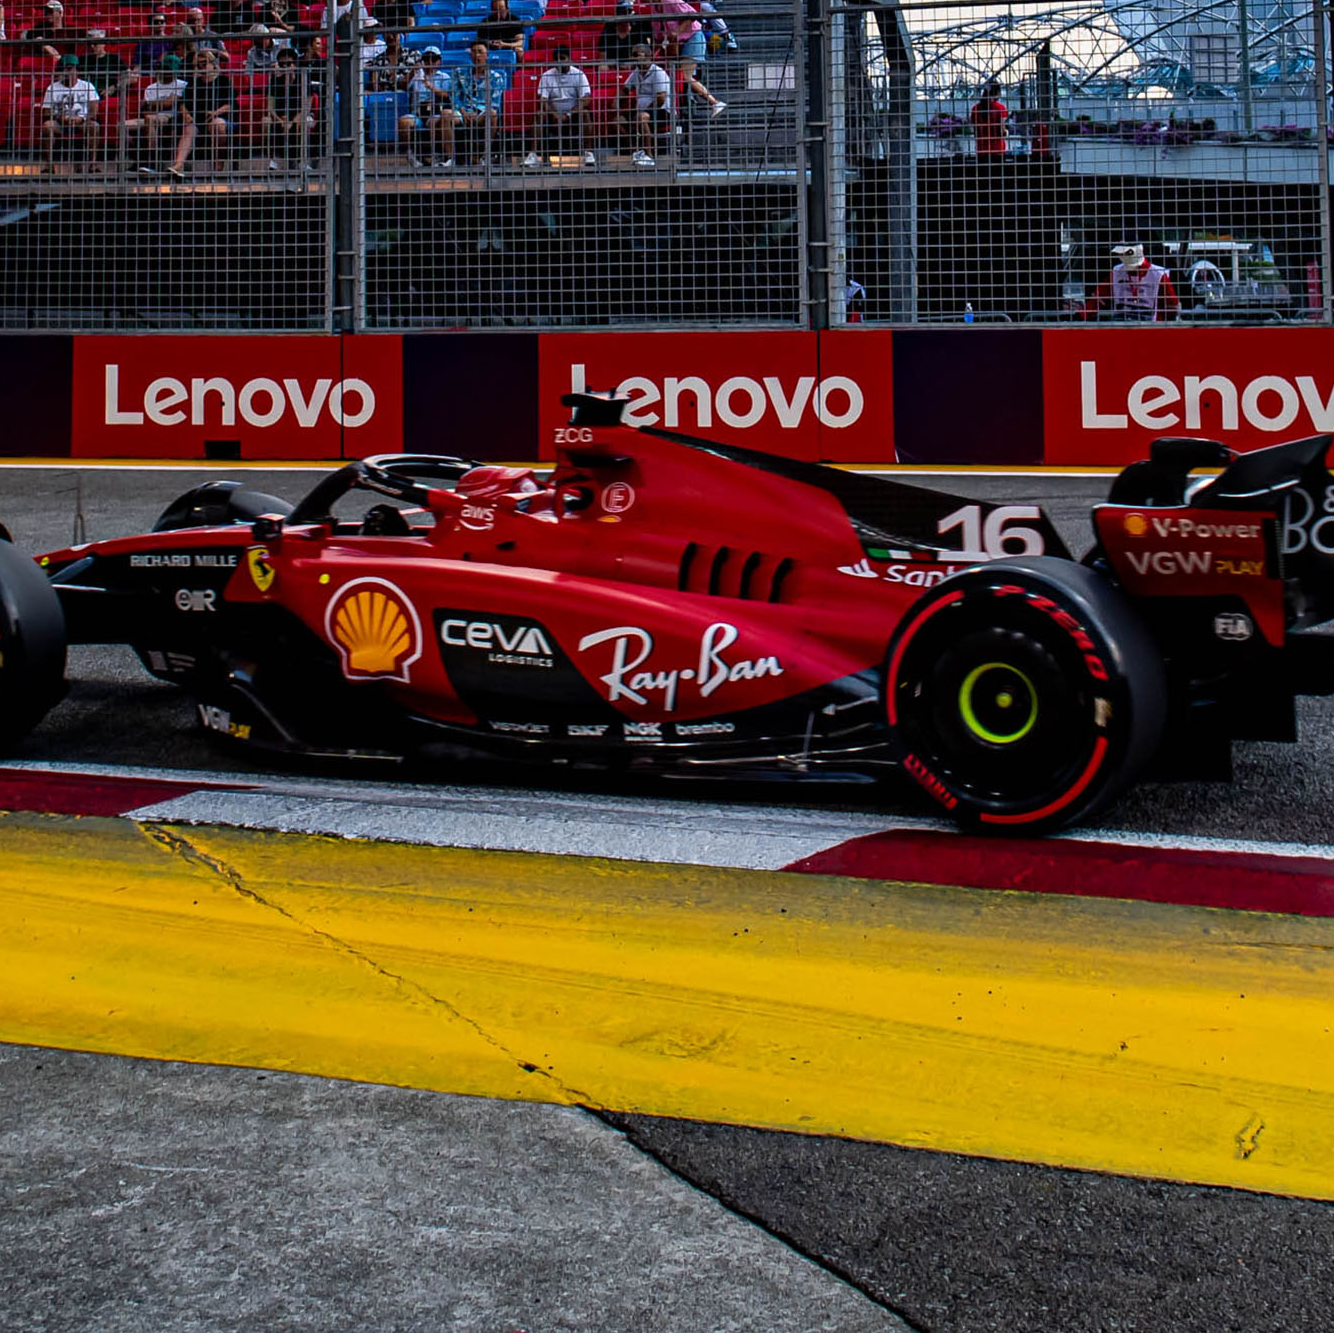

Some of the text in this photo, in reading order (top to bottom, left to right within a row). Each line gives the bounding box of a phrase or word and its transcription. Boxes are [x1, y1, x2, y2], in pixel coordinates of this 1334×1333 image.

[105, 364, 376, 428] Lenovo
[554, 428, 593, 443] ZCG
[937, 505, 1045, 562] 16
[1152, 517, 1261, 538] V-Power
[130, 555, 237, 567] RICHARD MILLE
[1125, 551, 1212, 574] VGW
[488, 652, 554, 667] LOGISTICS
[624, 722, 663, 735] NGK
[675, 722, 735, 735] brembo
